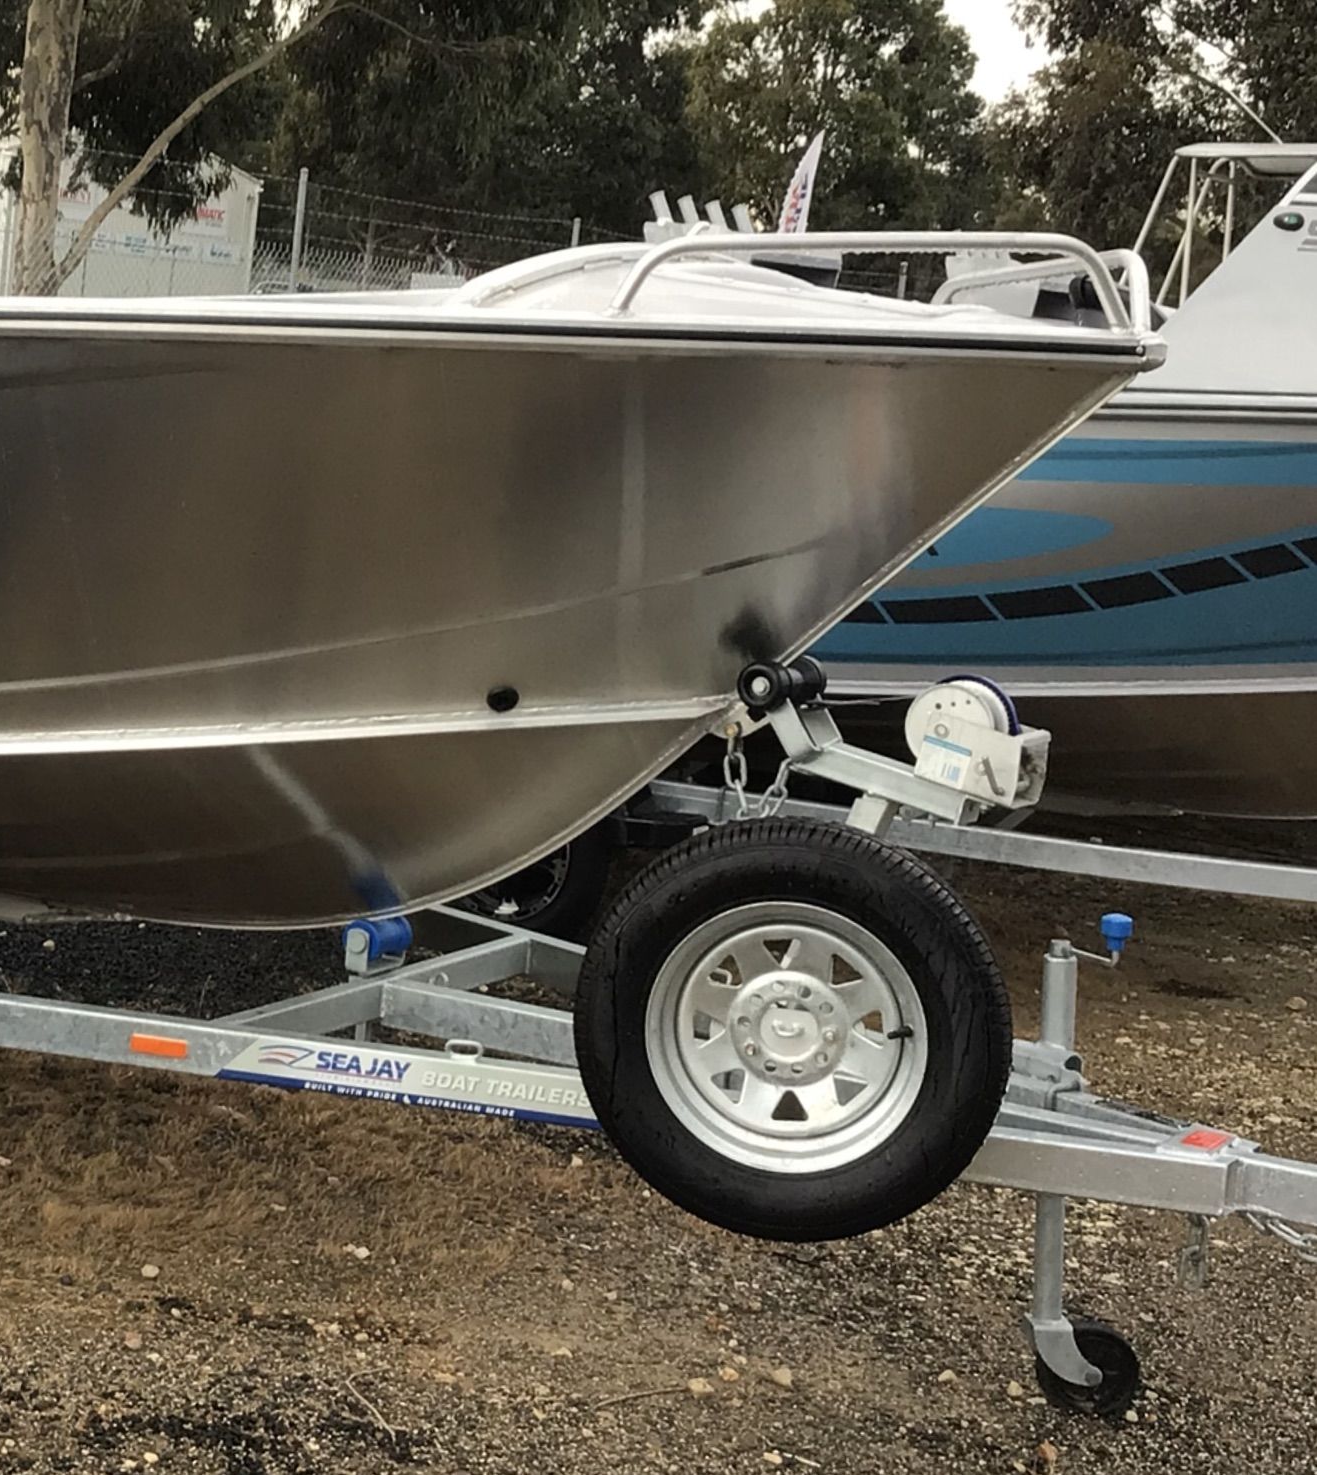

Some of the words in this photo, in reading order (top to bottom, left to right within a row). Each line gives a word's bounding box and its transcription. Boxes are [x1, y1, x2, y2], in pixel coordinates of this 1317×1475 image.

[304, 1081, 333, 1094] BUILT
[336, 1086, 363, 1098] WITH
[366, 1090, 397, 1102] PRIDE
[416, 1097, 482, 1114] AUSTRALIAN
[484, 1106, 516, 1119] MADE
[315, 1050, 363, 1076] SEA
[364, 1057, 412, 1082] JAY
[421, 1070, 480, 1095] BOAT
[485, 1078, 592, 1109] TRAILERS
